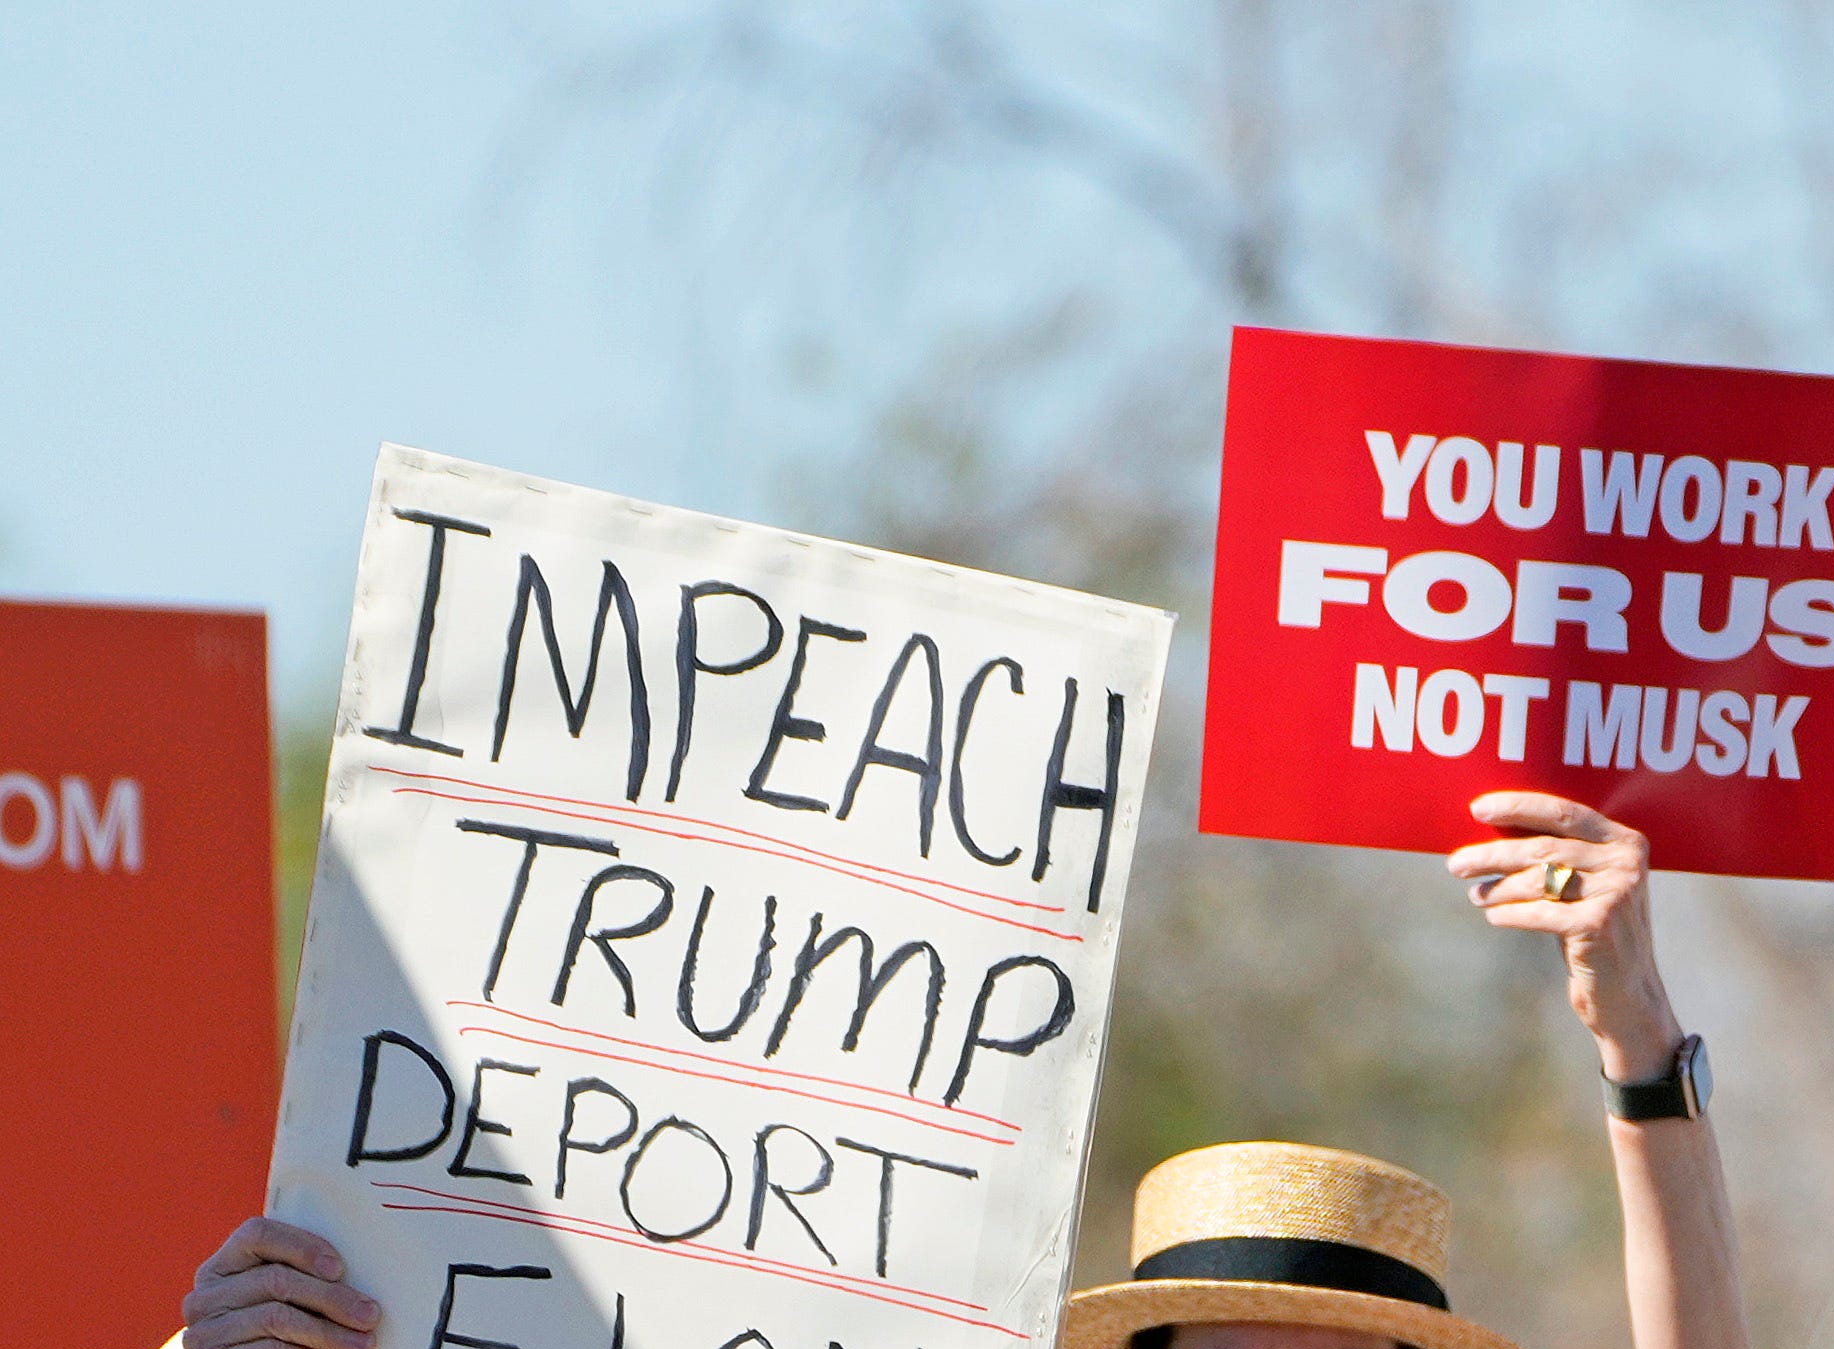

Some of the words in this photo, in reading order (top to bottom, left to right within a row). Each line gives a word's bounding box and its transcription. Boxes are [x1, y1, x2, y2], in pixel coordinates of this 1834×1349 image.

[1363, 429, 1561, 527] YOU
[1277, 539, 1634, 654] FOR
[363, 507, 1125, 913] IMPEACH
[1350, 661, 1550, 763] NOT
[1562, 679, 1811, 781] MUSK
[456, 818, 1075, 1107] TRUMP
[346, 1029, 980, 1278] DEPORT
